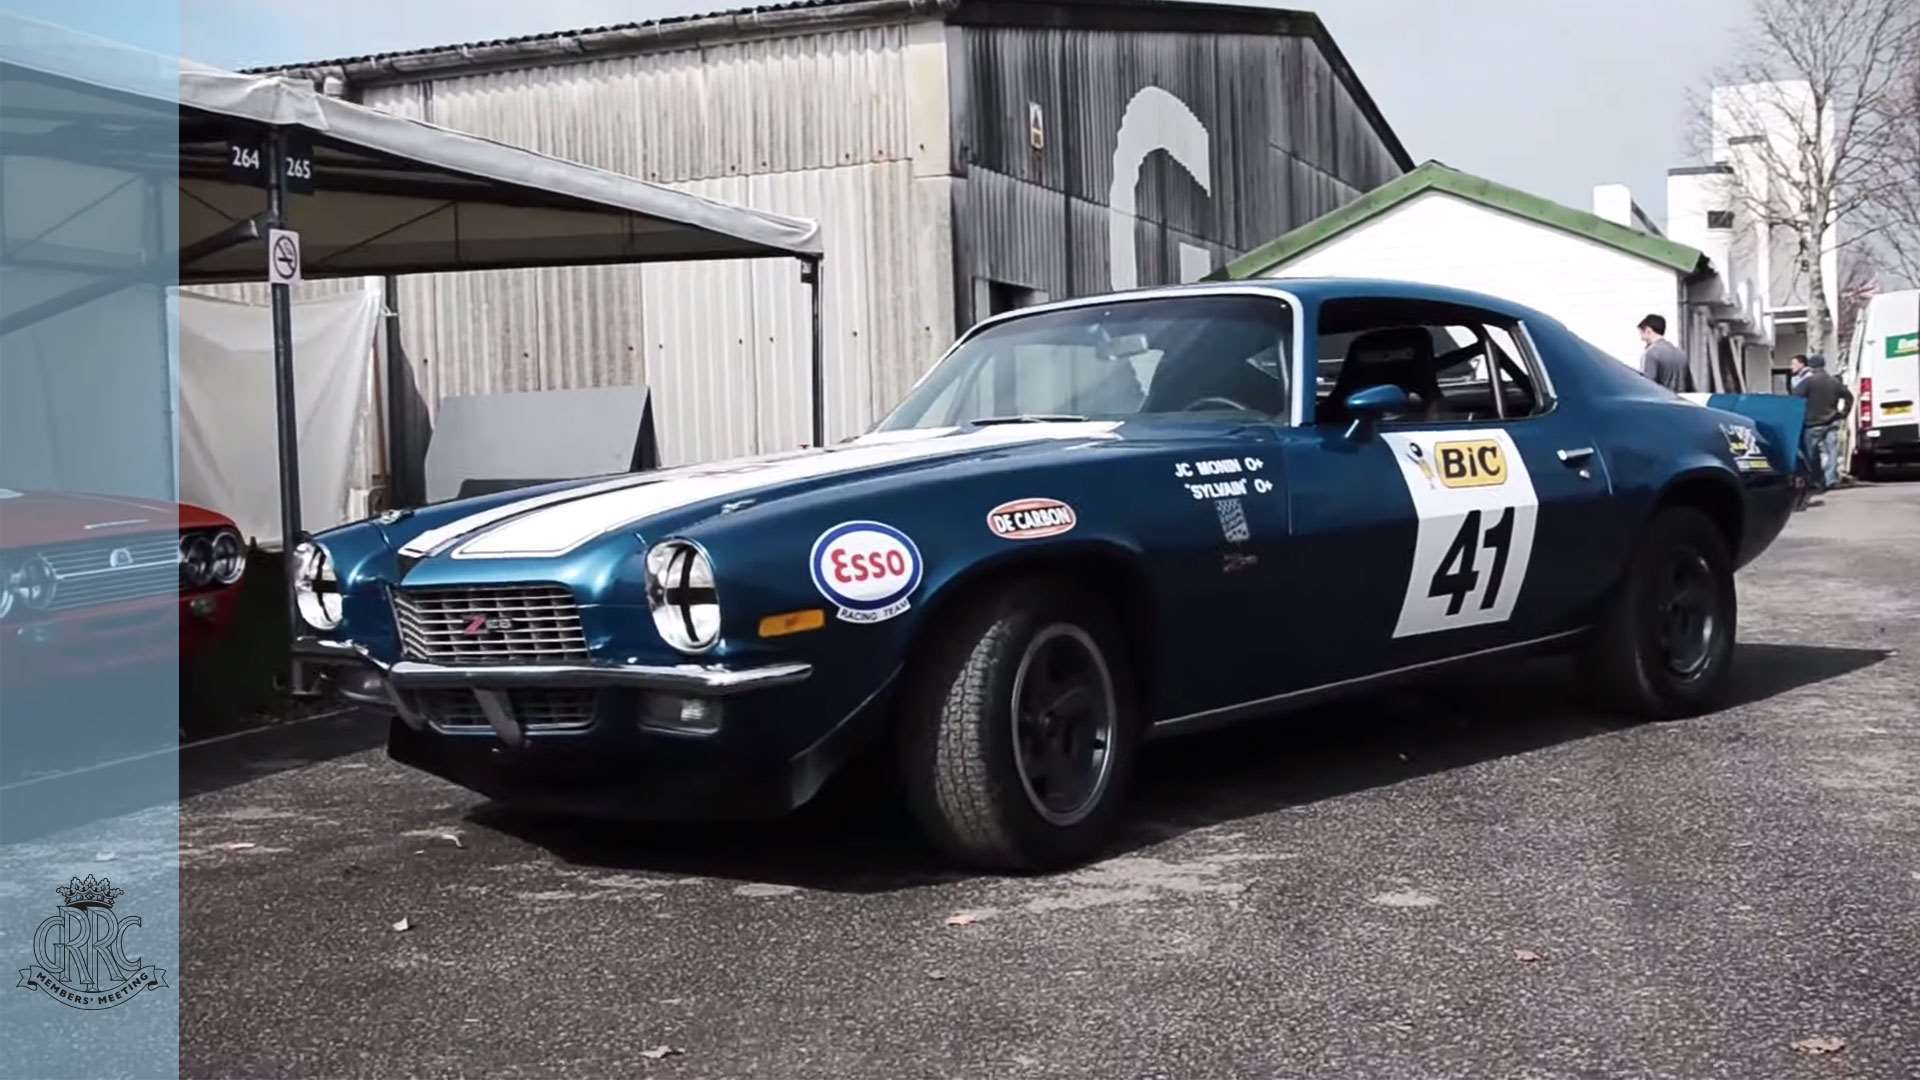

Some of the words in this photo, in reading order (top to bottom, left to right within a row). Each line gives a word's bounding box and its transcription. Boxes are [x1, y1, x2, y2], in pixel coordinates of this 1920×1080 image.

[232, 145, 260, 169] 264
[285, 157, 311, 179] 265
[1174, 462, 1194, 477] JC
[1195, 458, 1243, 475] MONIN
[992, 513, 1016, 533] DE
[1014, 506, 1072, 530] CARBON
[1427, 506, 1516, 616] 41
[840, 608, 878, 621] RACING
[883, 599, 909, 616] TEAM
